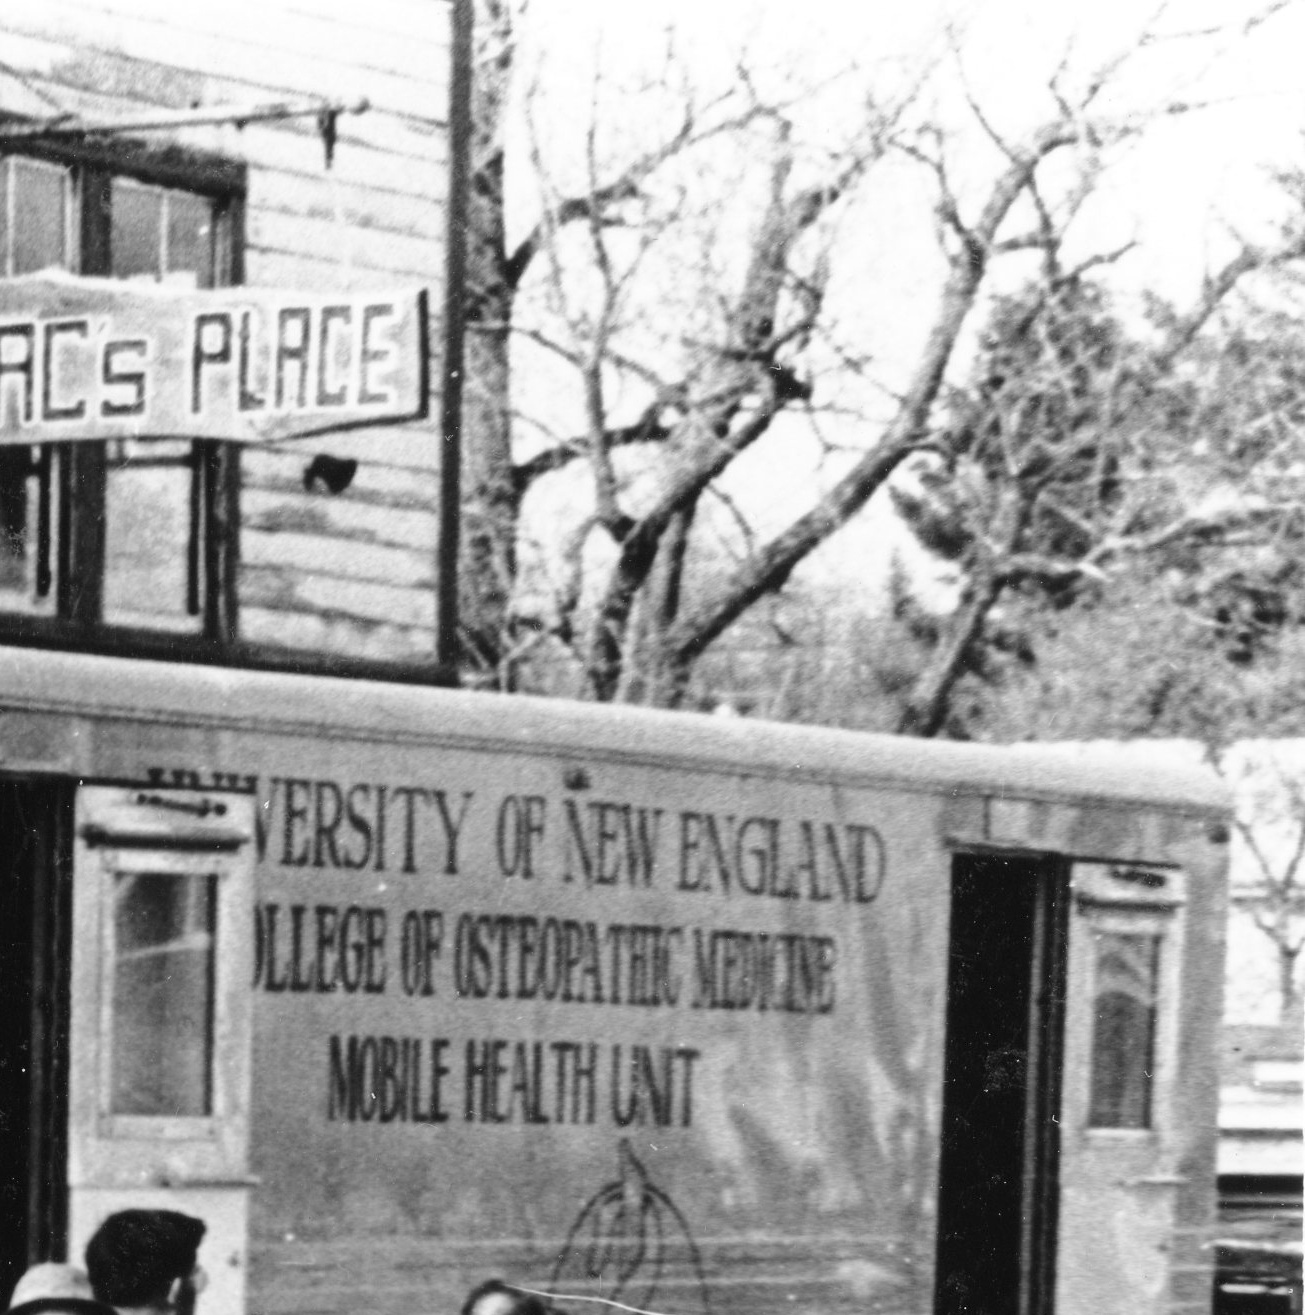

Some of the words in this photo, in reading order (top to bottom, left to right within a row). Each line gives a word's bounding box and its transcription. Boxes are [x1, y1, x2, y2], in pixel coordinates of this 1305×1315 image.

[192, 303, 394, 414] PLACE
[146, 766, 473, 875] VERSITY
[496, 794, 547, 880] OF
[562, 797, 664, 888] NEW
[677, 811, 886, 904] ENGLAND
[251, 904, 387, 994] LLEGE
[401, 909, 444, 998] OF
[453, 911, 684, 1008] OSTEOPATHIC
[690, 927, 835, 1014] MEDICINE
[328, 1034, 451, 1124] MOBILE
[464, 1038, 599, 1125] HEALTH
[611, 1043, 701, 1127] UNIT
